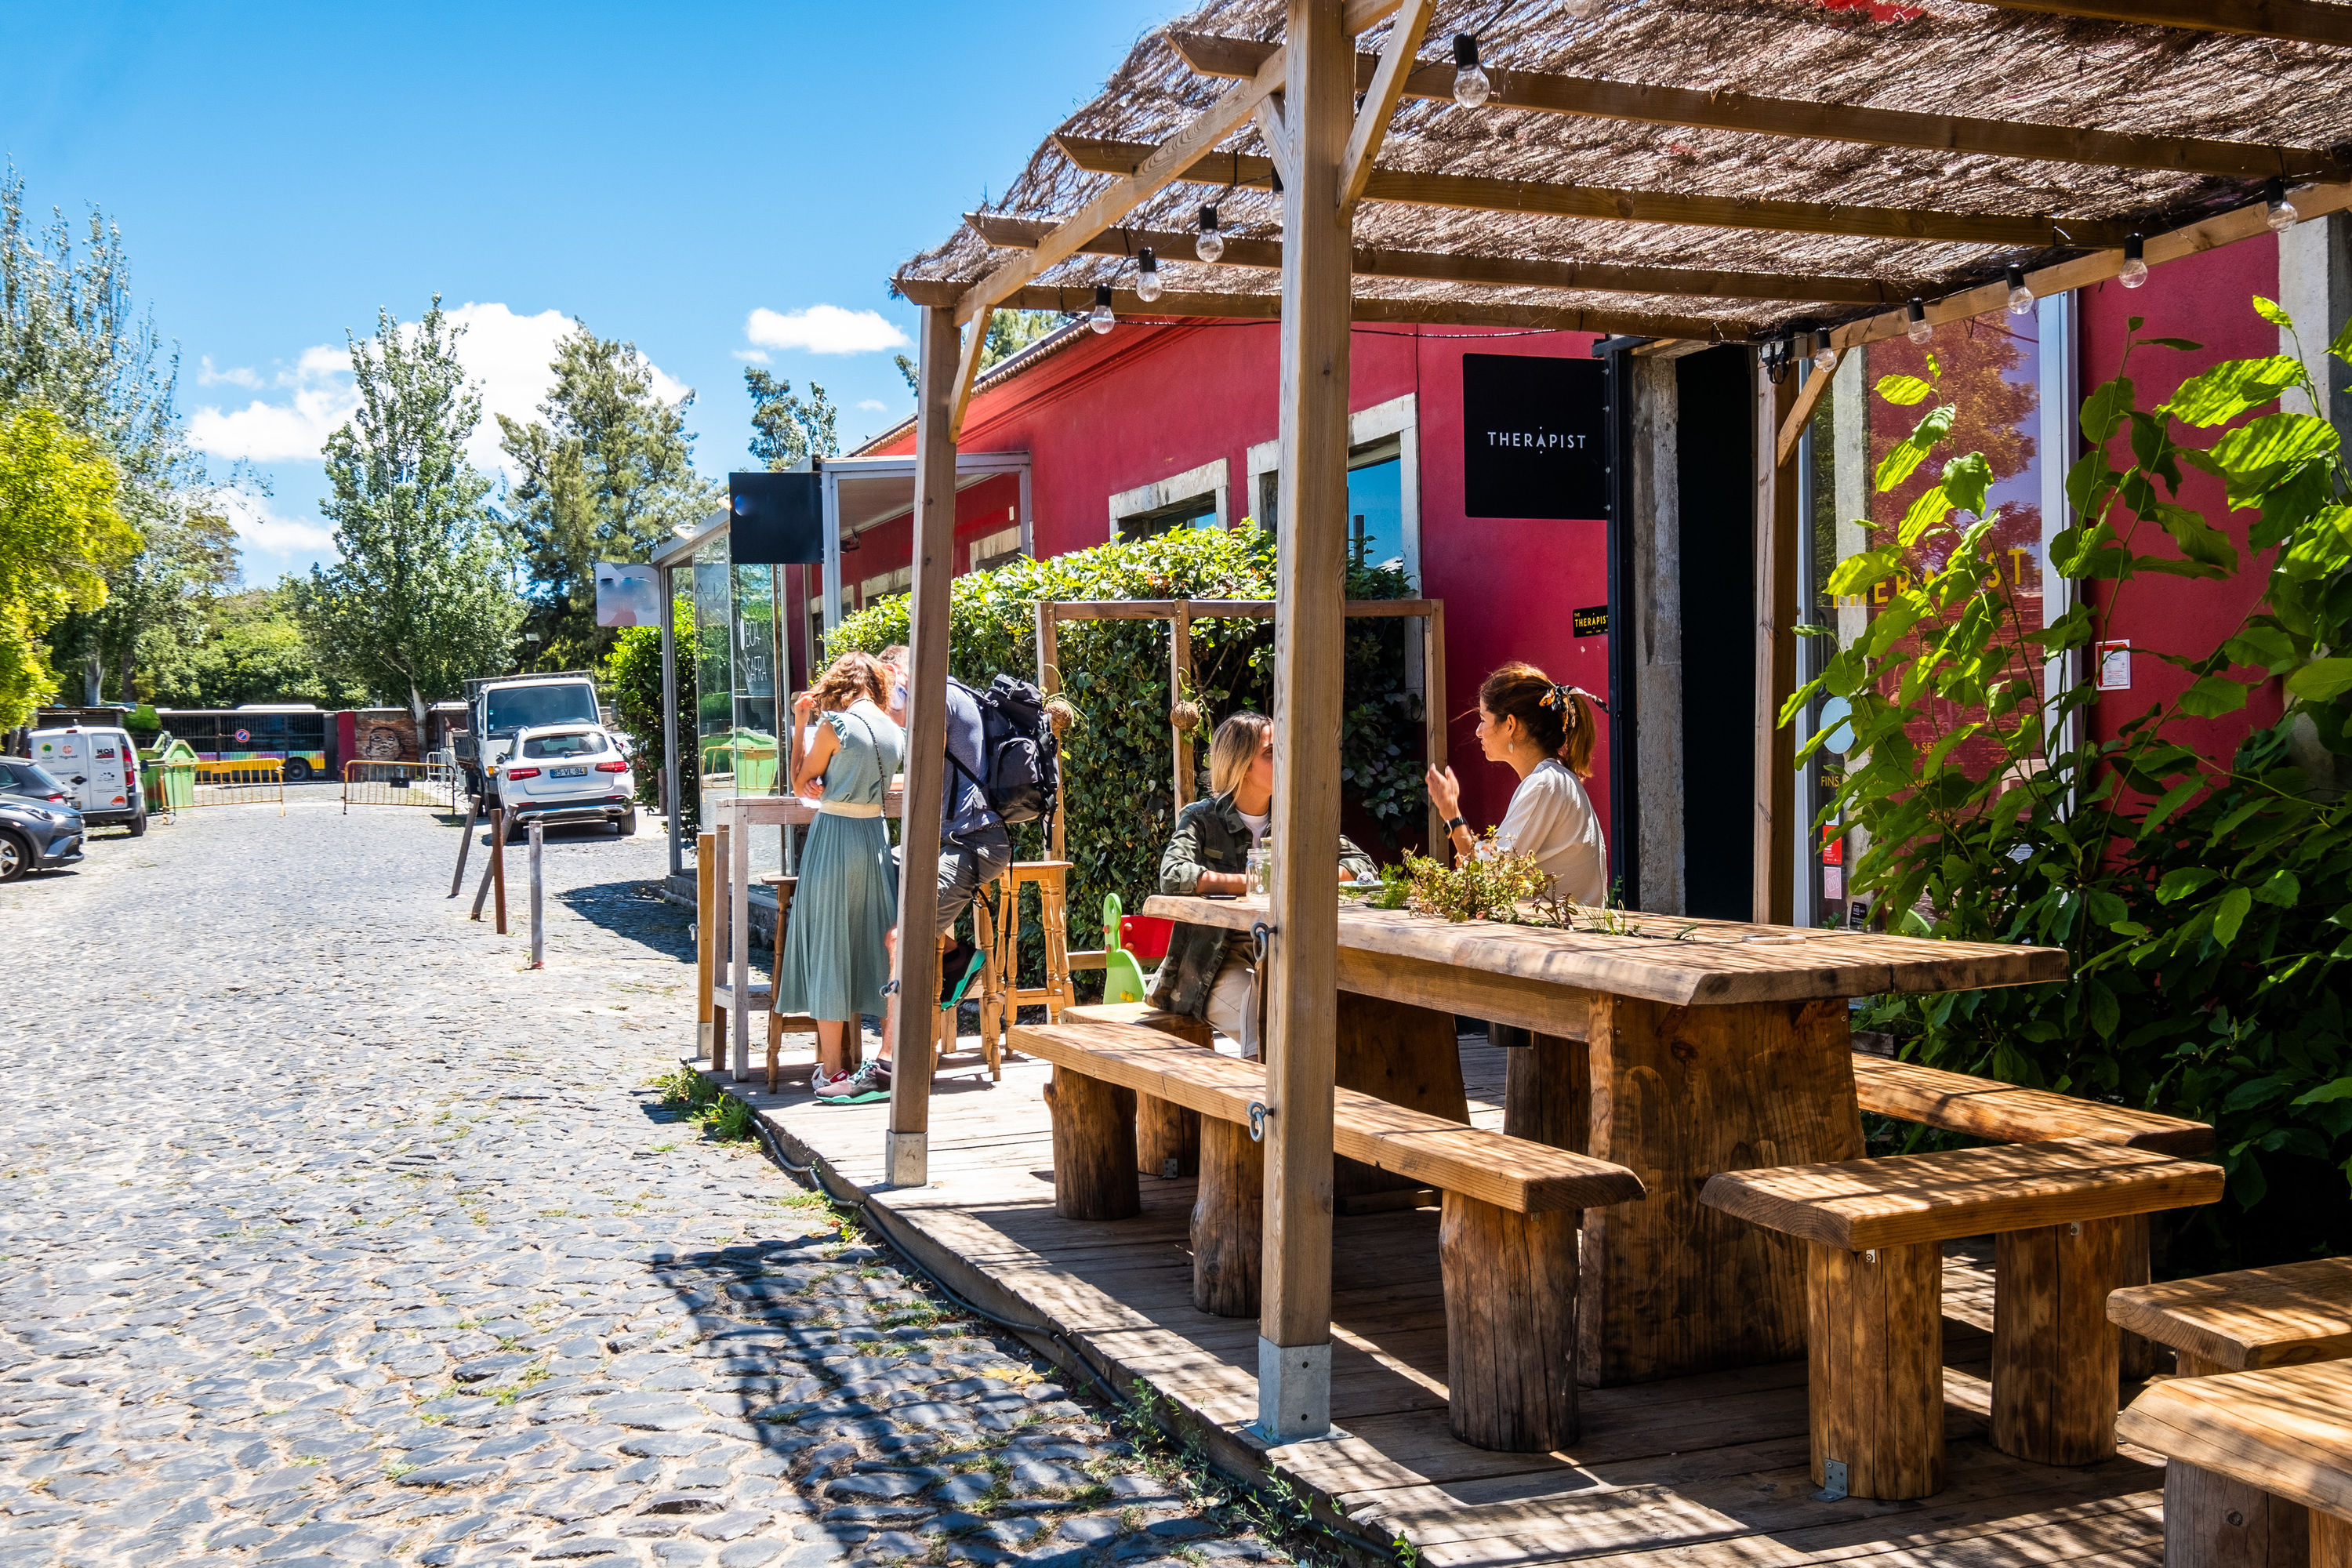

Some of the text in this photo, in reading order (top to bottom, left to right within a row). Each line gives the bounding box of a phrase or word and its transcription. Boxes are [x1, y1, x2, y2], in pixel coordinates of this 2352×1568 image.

[1487, 430, 1586, 449] THERAPIST
[1574, 615, 1609, 628] THERAPIS
[1820, 775, 1840, 787] FINS
